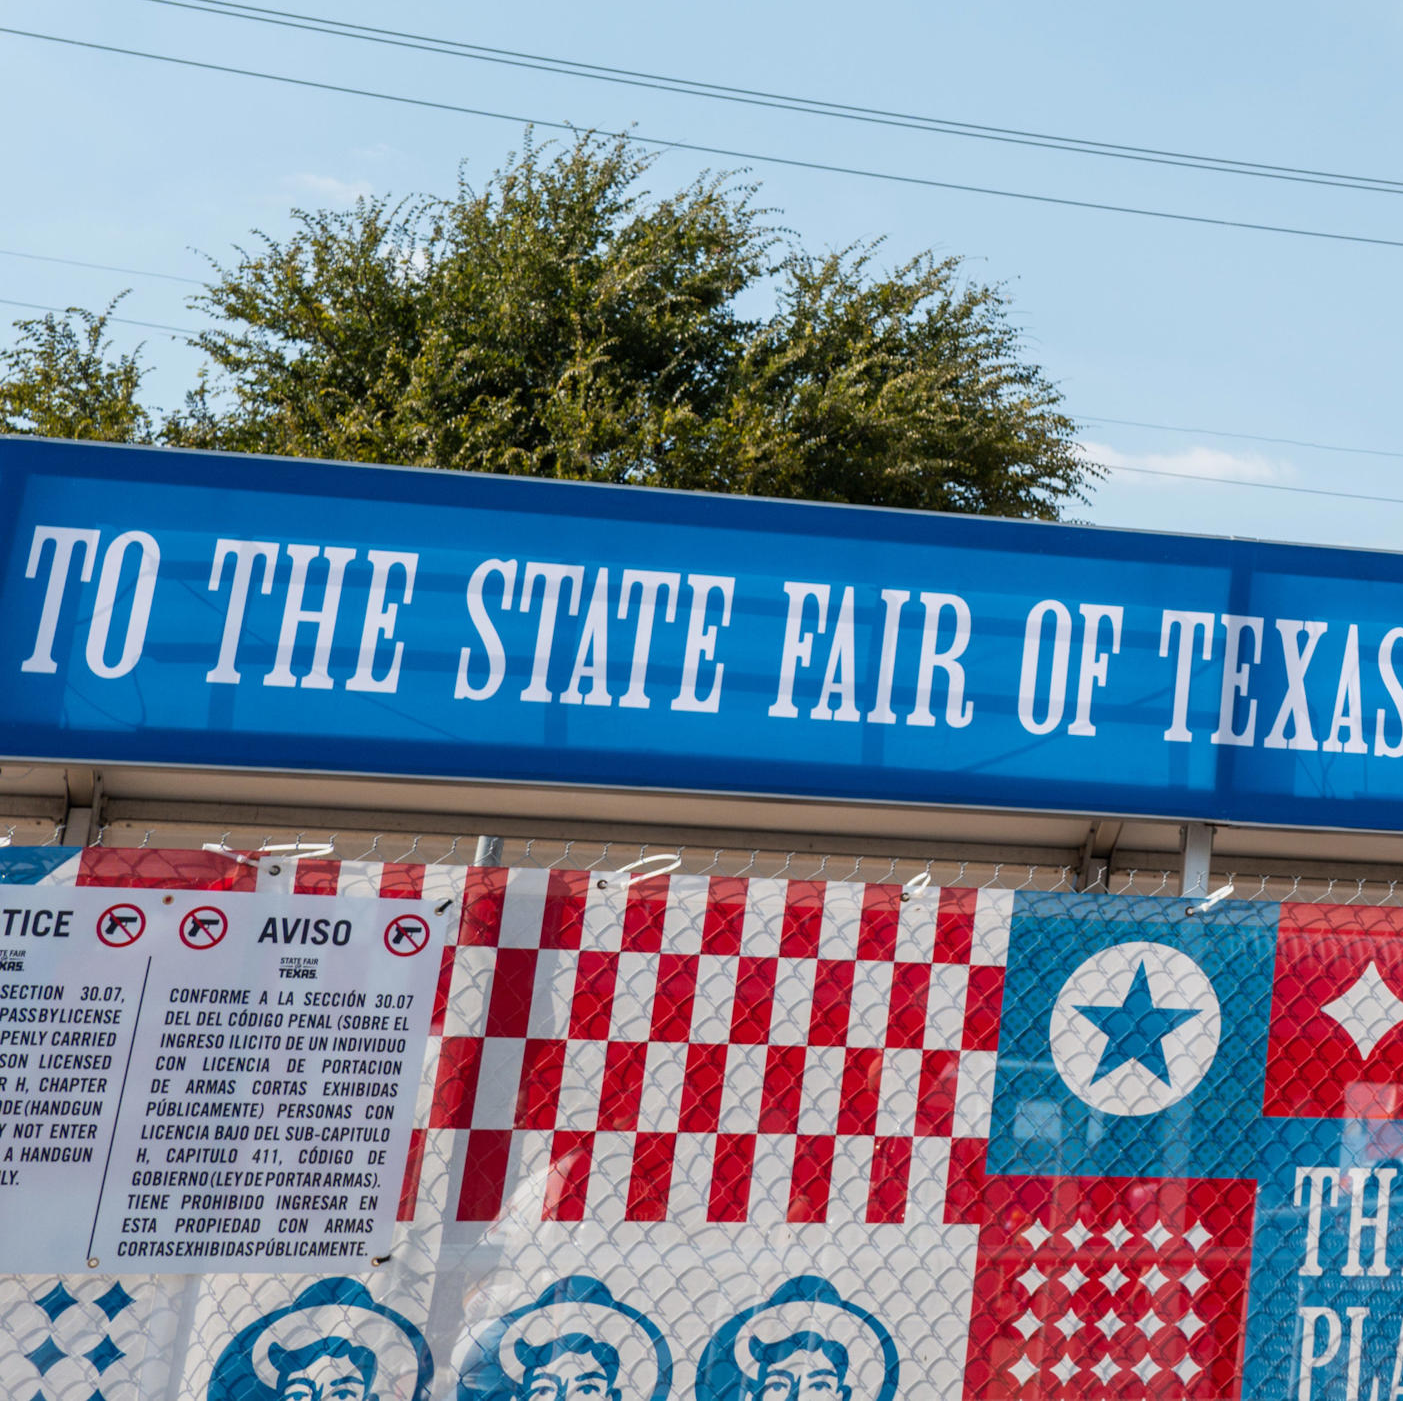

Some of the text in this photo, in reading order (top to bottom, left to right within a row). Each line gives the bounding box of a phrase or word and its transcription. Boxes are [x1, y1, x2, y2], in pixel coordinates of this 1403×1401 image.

[20, 524, 161, 680] TO
[206, 538, 419, 694] THE
[454, 557, 736, 713] STATE
[767, 580, 974, 728] FAIR
[1017, 599, 1124, 737] OF
[257, 917, 352, 946] AVISO
[280, 957, 319, 965] STATE FAIR
[0, 984, 125, 1003] SECTION 30.07,
[170, 987, 414, 1009] CONFORME A LA SECCIÓN 30.07
[165, 1008, 410, 1032] DEL DEL CÓDIGO PENAL (SOBRE EL
[51, 1031, 117, 1047] CARRIED
[160, 1033, 406, 1053] INGRESO ILICITO DE UN INDIVIDUO
[38, 1054, 112, 1070] LICENSED
[155, 1056, 402, 1076] CON LICENCIA DE PORTACION
[15, 1076, 29, 1094] H,
[38, 1076, 107, 1093] CHAPTER
[150, 1079, 399, 1098] DE ARMAS CORTAS EXHIBIDAS
[146, 1098, 395, 1120] PÚBLICAMENTE) PERSONAS CON
[13, 1123, 44, 1139] NOT
[50, 1124, 98, 1140] ENTER
[141, 1124, 390, 1143] LICENCIA BAJO DEL SUB-CAPITULO
[3, 1146, 93, 1163] A HANDGUN
[136, 1146, 386, 1166] H, CAPITULO 411, CÓDIGO DE
[132, 1171, 208, 1187] GOBIERNO
[244, 1172, 265, 1187] DE
[127, 1194, 378, 1211] TIENE PROHIBIDO INGRESAR EN
[122, 1218, 374, 1234] ESTA PROPIEDAD CON ARMAS
